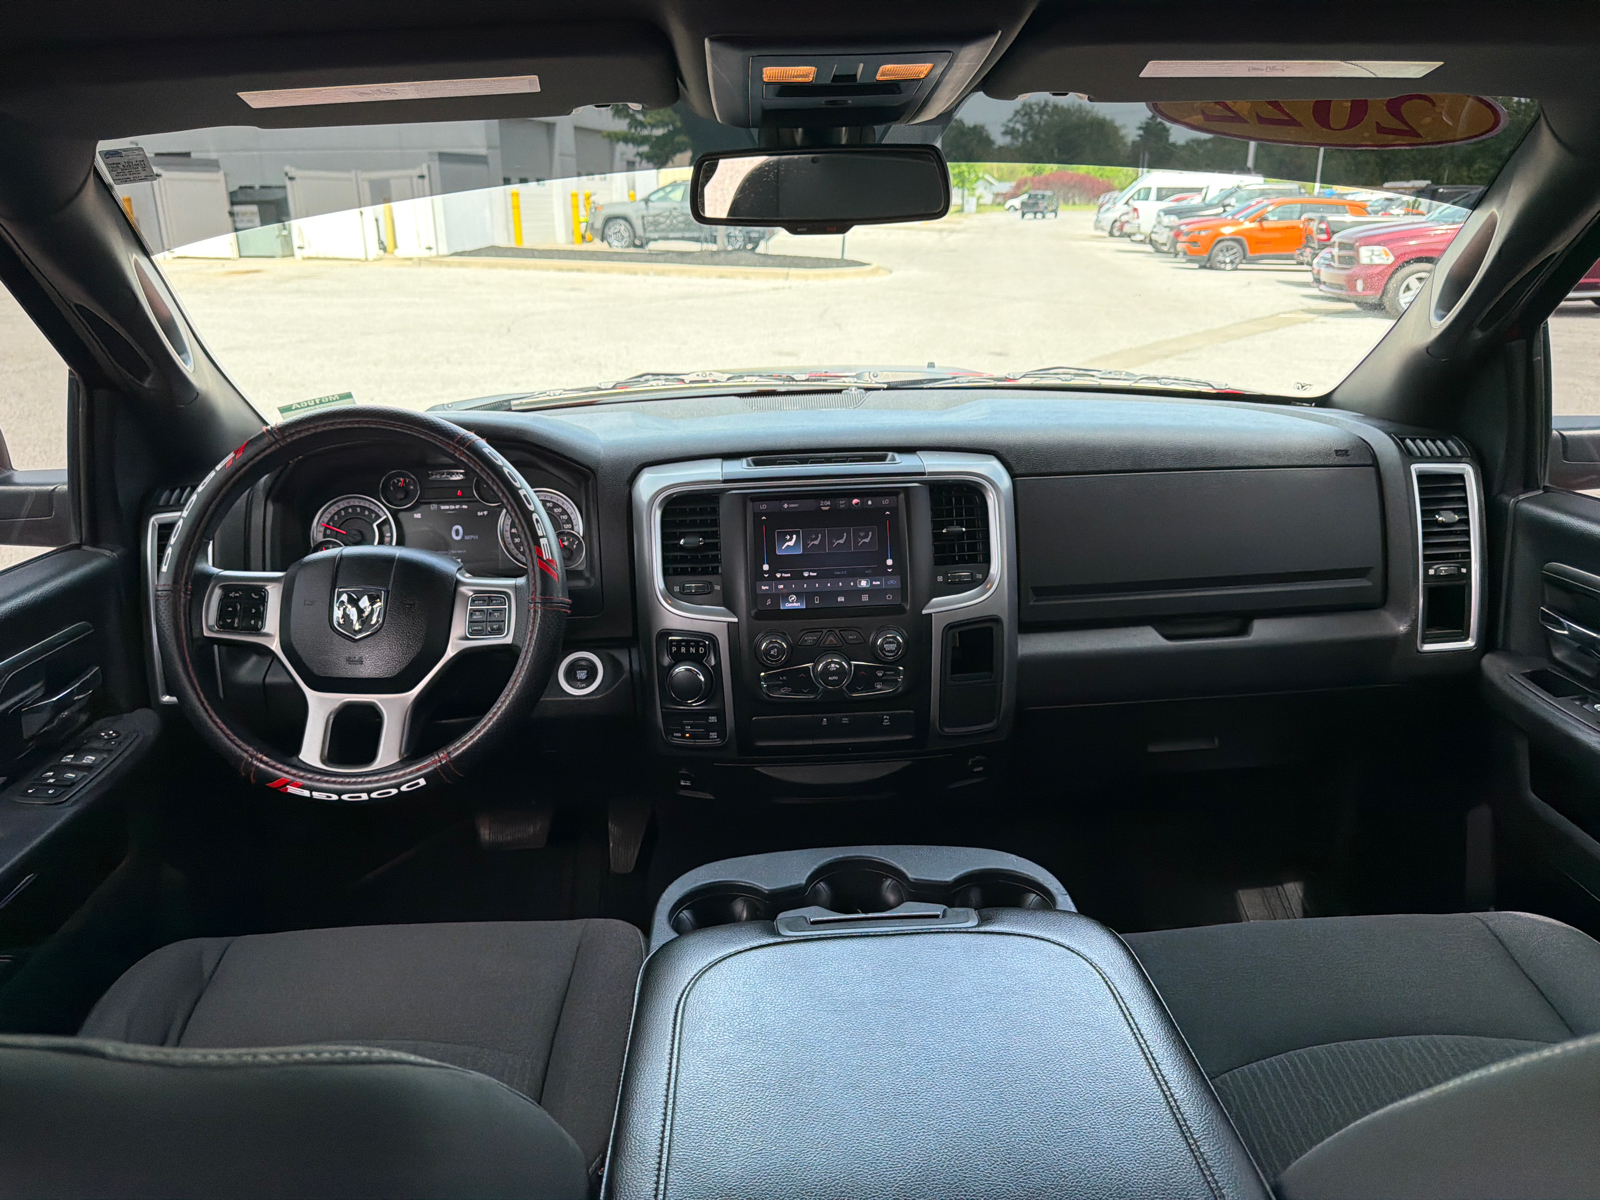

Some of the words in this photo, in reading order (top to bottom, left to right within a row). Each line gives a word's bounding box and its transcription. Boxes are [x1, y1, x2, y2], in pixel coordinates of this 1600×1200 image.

[161, 451, 235, 573] DODGE
[451, 524, 463, 540] 0
[482, 447, 552, 560] DODGE
[286, 777, 427, 801] DODGE
